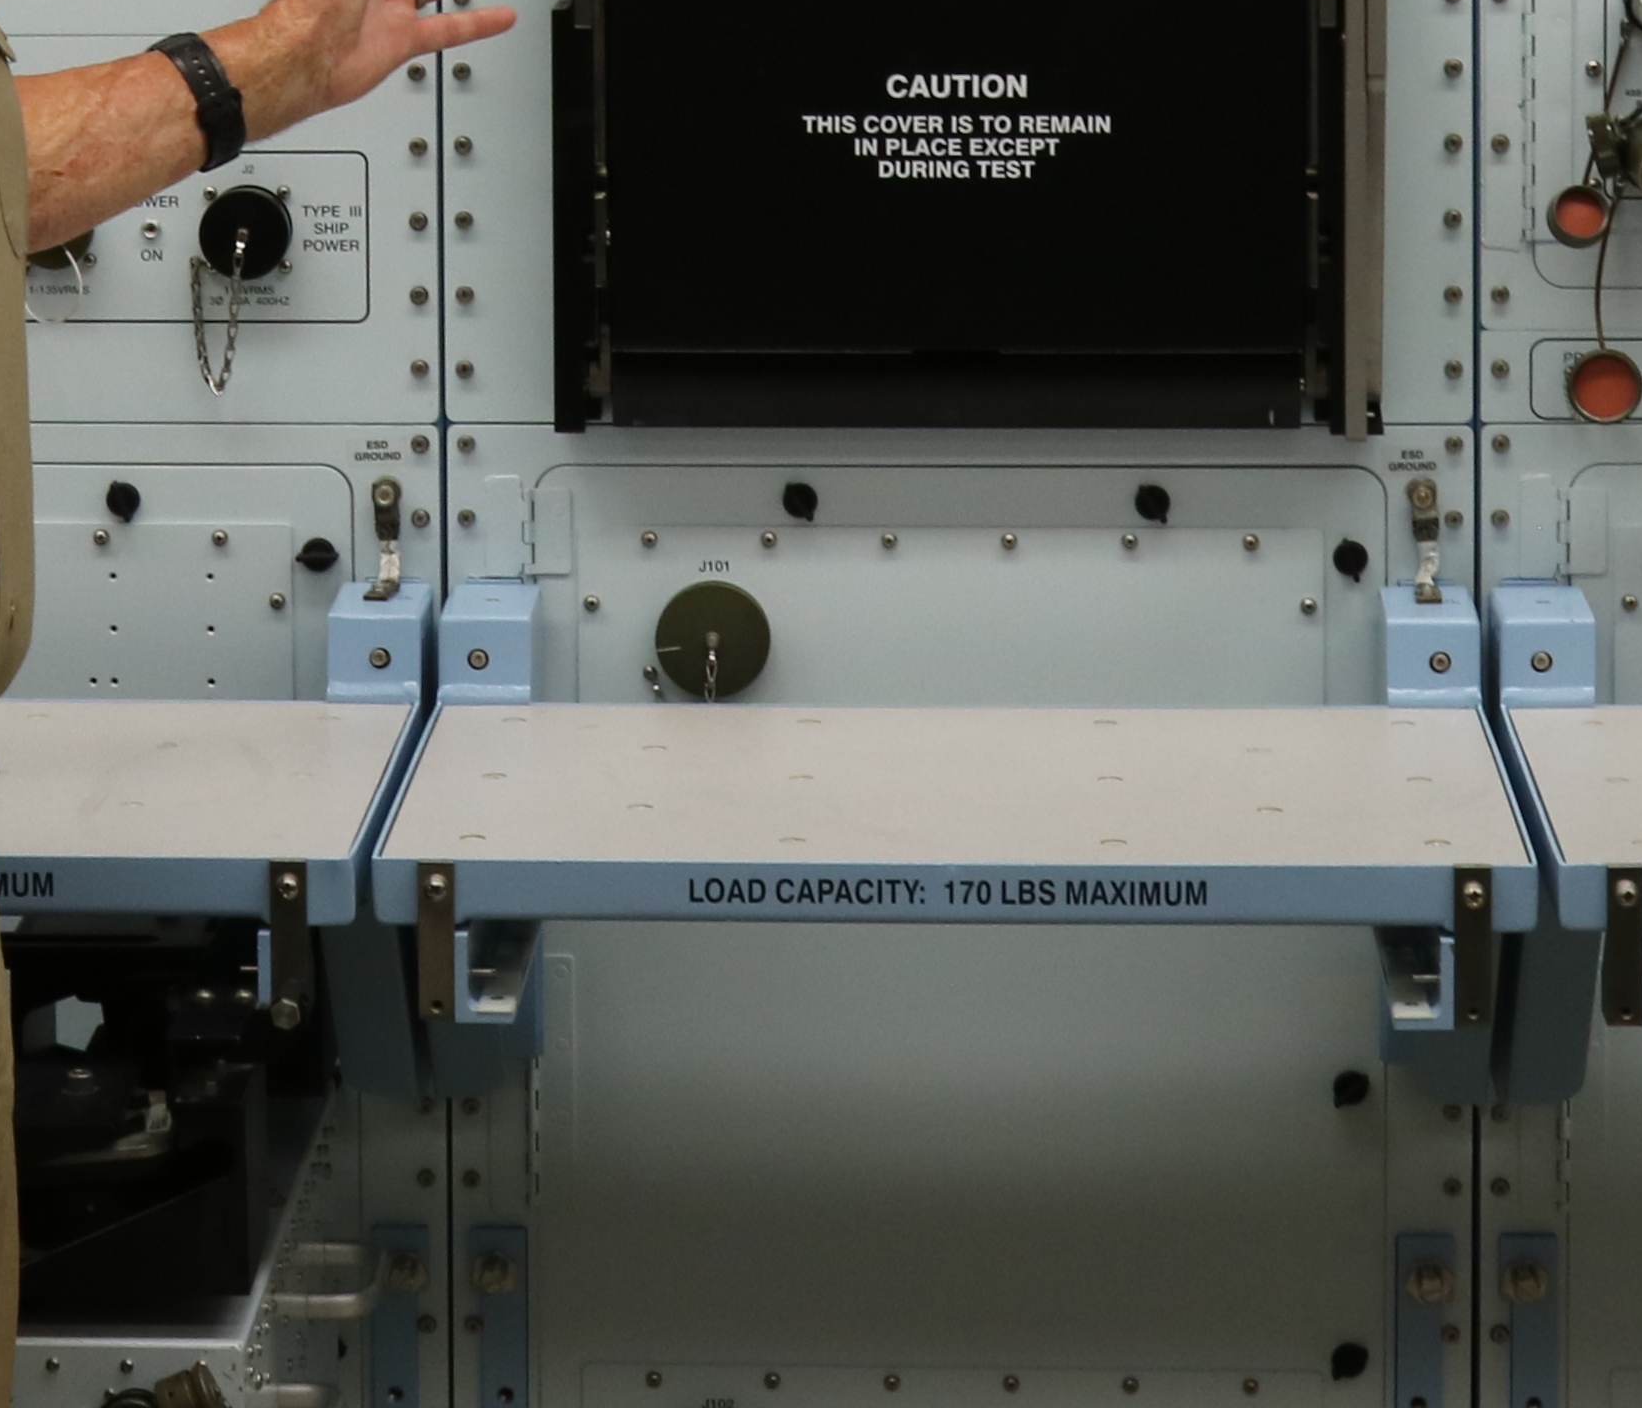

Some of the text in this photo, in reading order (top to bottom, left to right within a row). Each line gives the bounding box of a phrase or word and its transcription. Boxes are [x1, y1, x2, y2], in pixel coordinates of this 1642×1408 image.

[886, 74, 1028, 100] CAUTION
[802, 115, 1112, 135] THIS COVER IS TO REMAIN
[853, 138, 1060, 157] IN PLACE EXCEPT
[242, 165, 255, 174] J2
[878, 160, 1036, 180] DURING TEST
[302, 206, 363, 218] TYPE III
[314, 223, 349, 235] SHIP
[303, 239, 360, 252] POWER
[141, 249, 163, 262] ON
[256, 296, 290, 306] 400HZ
[366, 441, 388, 450] ESD
[354, 451, 402, 461] GROUND
[1400, 450, 1424, 460] ESD
[1388, 462, 1437, 472] GROUND
[698, 560, 731, 573] J101
[688, 878, 1208, 907] LOAD CAPACITY: 170 LBS MAXIMUM
